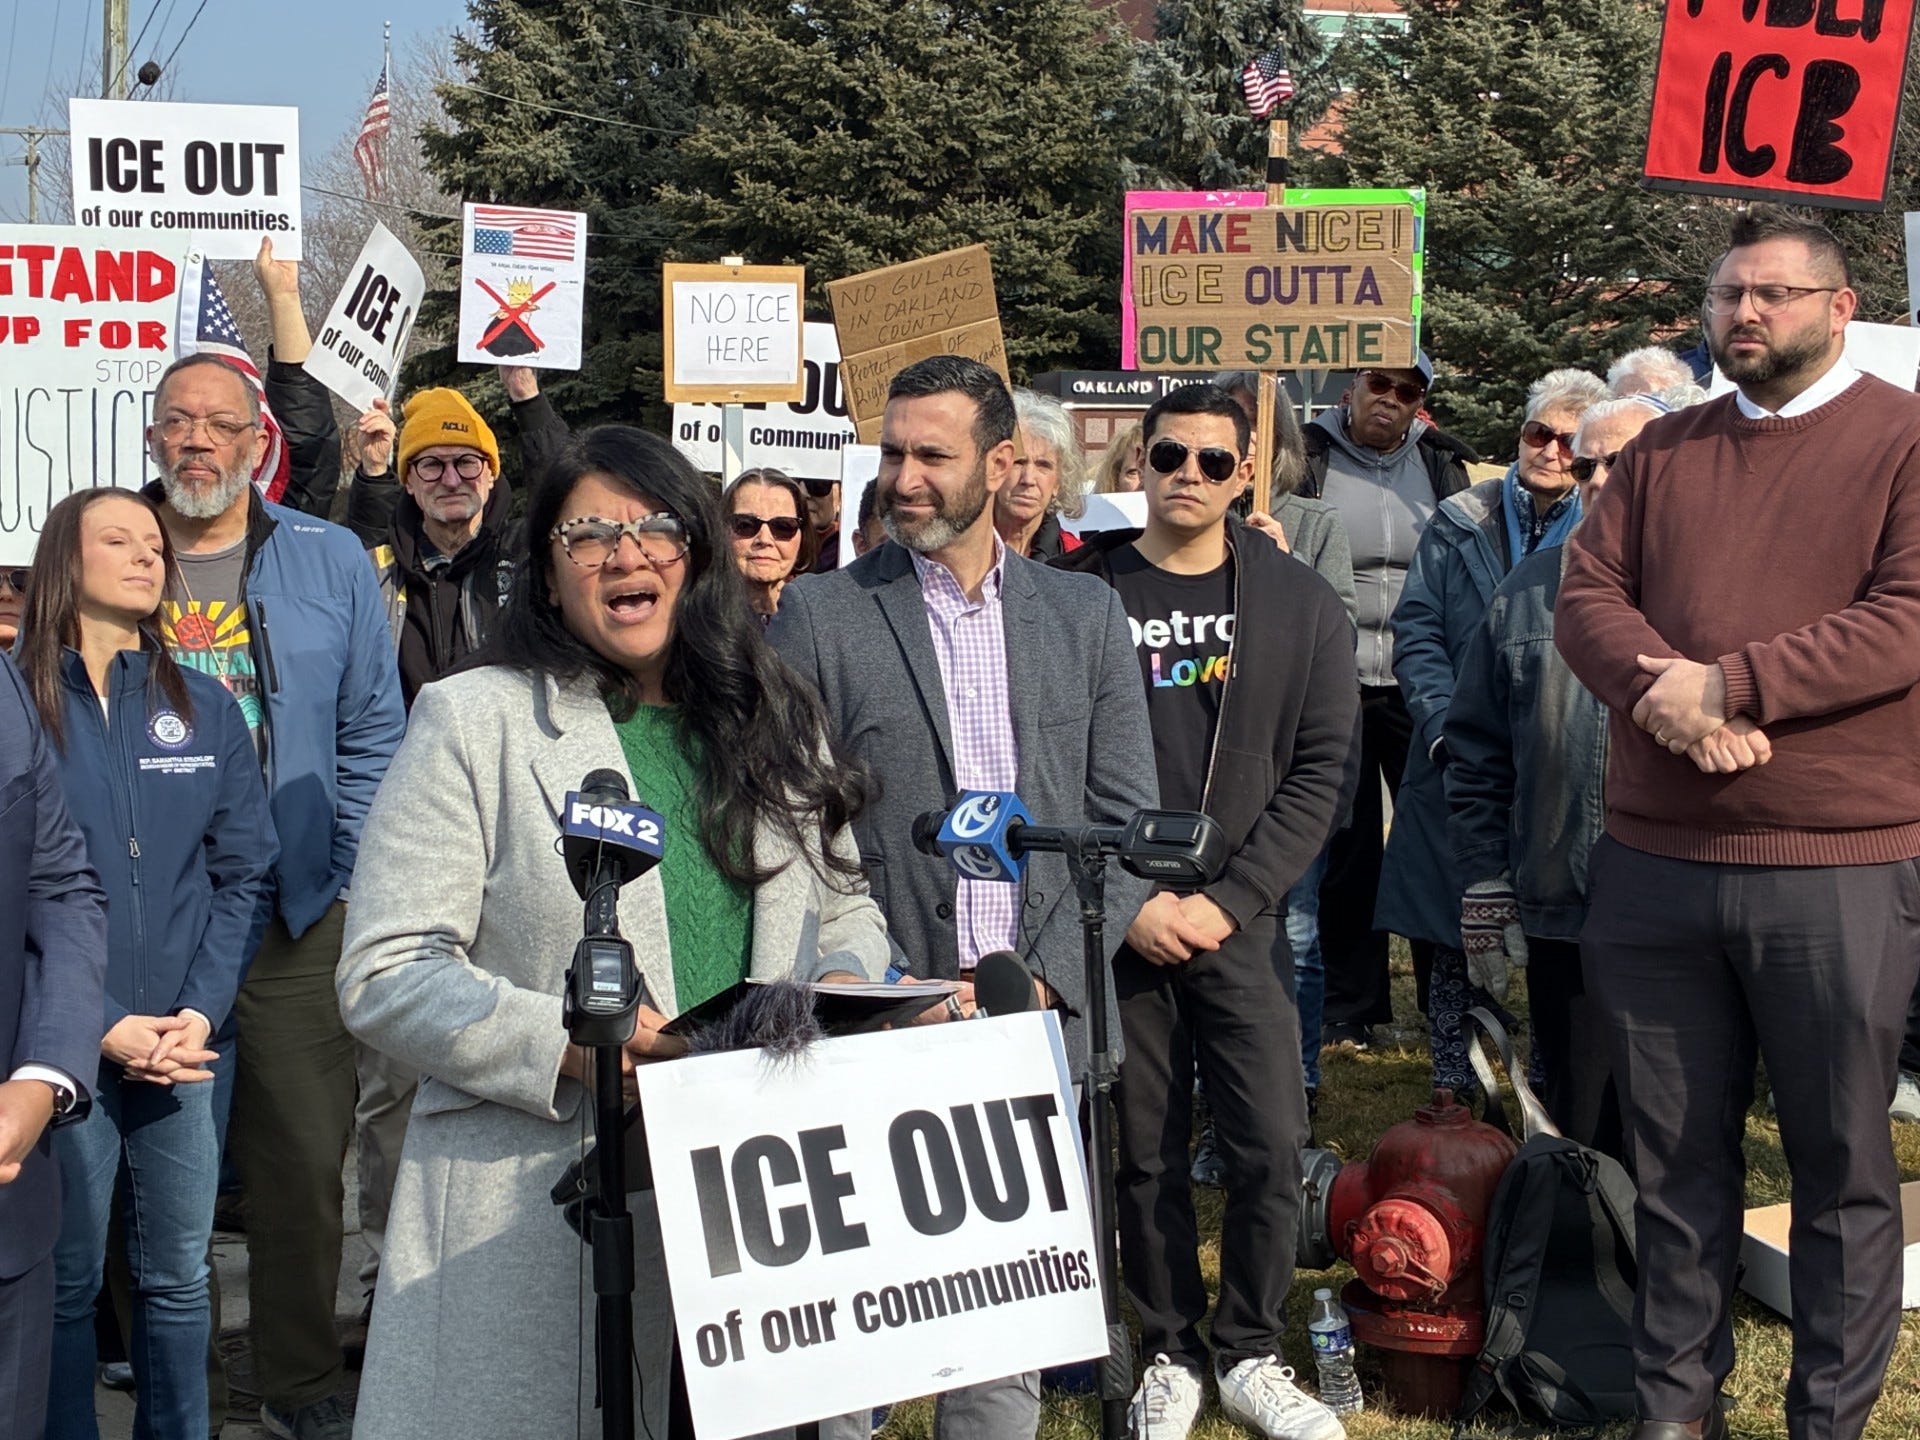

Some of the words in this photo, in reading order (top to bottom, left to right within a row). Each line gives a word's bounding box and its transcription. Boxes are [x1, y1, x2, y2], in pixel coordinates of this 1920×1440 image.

[88, 137, 165, 193] ICE
[184, 140, 285, 197] OUT
[81, 205, 102, 227] of
[108, 208, 144, 229] our
[150, 209, 297, 232] communities.
[1136, 213, 1252, 255] MAKE
[1275, 209, 1401, 256] NICE!
[343, 263, 402, 346] ICE
[841, 284, 877, 309] NO
[892, 259, 976, 296] GULAG
[1141, 264, 1224, 307] ICE
[1245, 265, 1383, 306] OUTTA
[690, 292, 736, 324] NO
[745, 293, 791, 324] ICE
[850, 310, 872, 332] IN
[884, 282, 984, 323] OAKLAND
[878, 304, 959, 345] COUNTY
[64, 319, 168, 352] FOR
[321, 326, 343, 351] of
[337, 340, 365, 369] our
[707, 335, 769, 365] HERE
[1140, 324, 1223, 366] OUR
[1245, 322, 1382, 366] STATE
[96, 359, 162, 383] STOP
[787, 360, 850, 418] OU
[1072, 381, 1153, 395] OAKLAND
[441, 421, 469, 433] ACLU
[680, 420, 701, 442] of
[750, 427, 856, 451] communit
[1127, 610, 1237, 649] etro
[571, 801, 634, 836] FOX
[637, 818, 659, 845] 2
[690, 1124, 870, 1278] ICE
[888, 1093, 1068, 1236] OUT
[696, 1308, 745, 1368] of
[761, 1296, 837, 1354] our
[853, 1245, 1096, 1334] communities.
